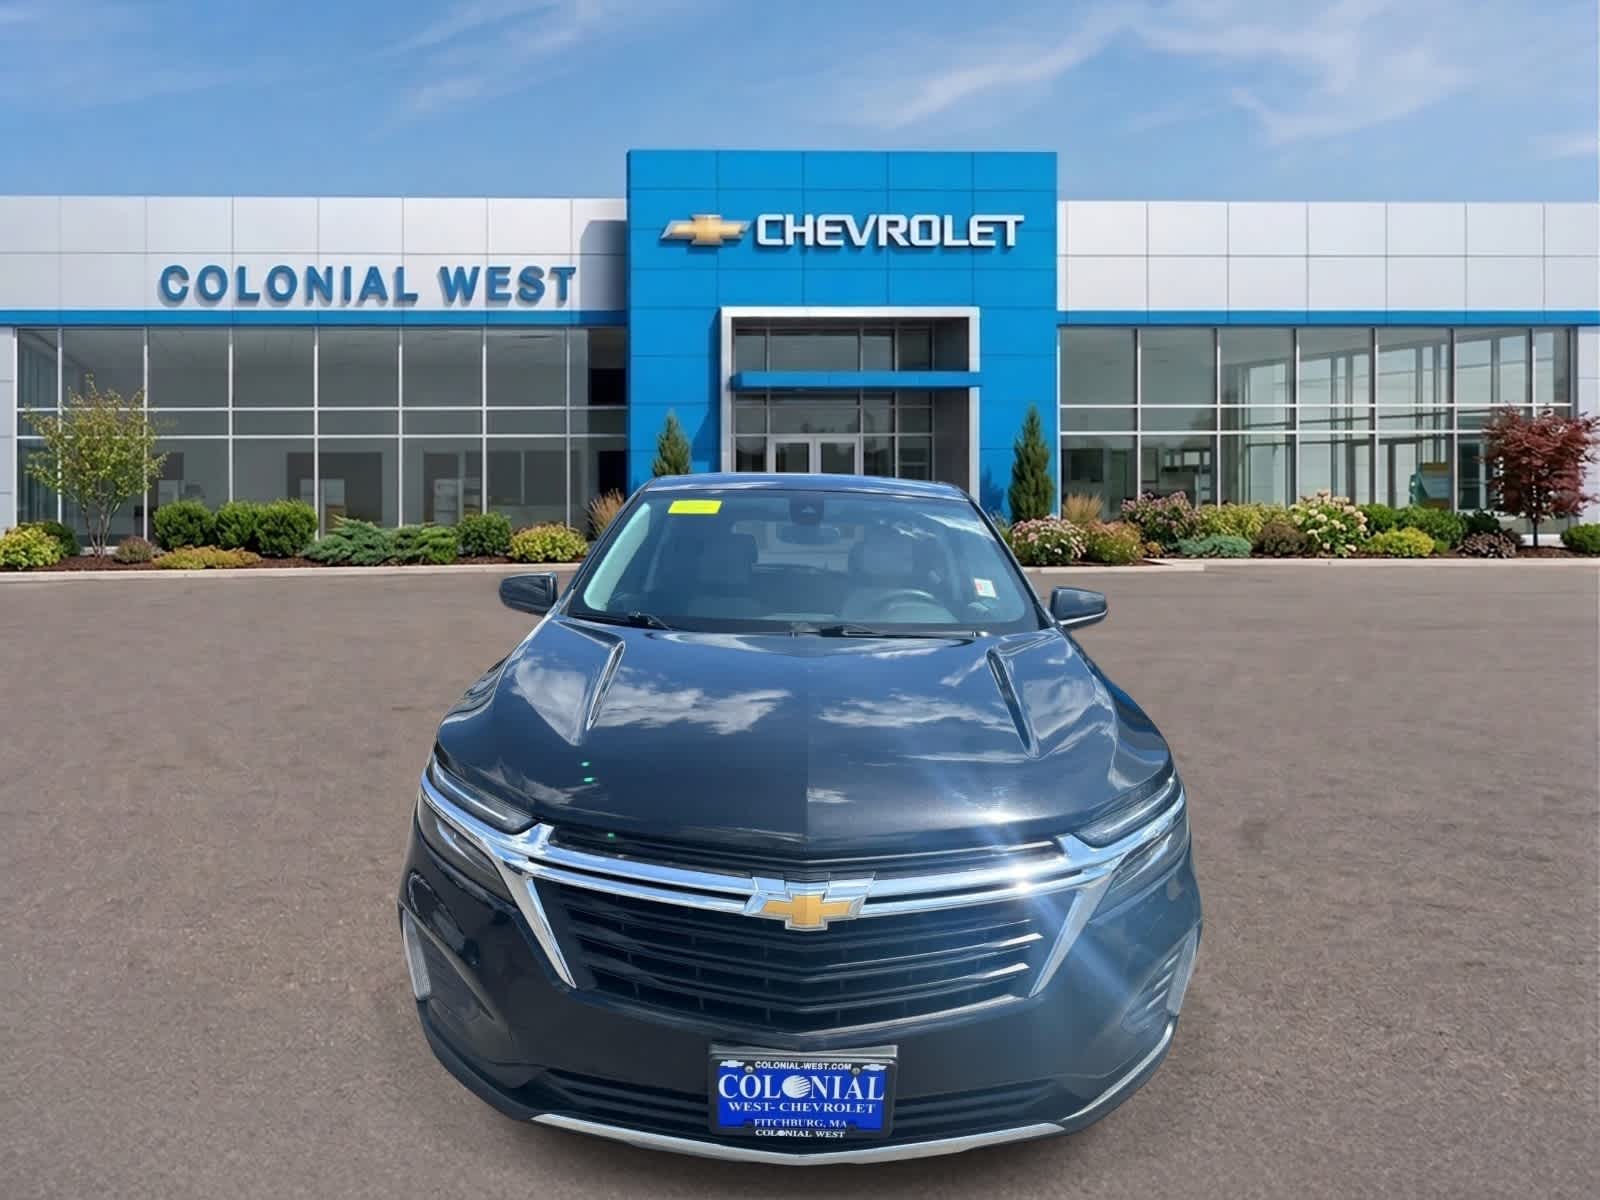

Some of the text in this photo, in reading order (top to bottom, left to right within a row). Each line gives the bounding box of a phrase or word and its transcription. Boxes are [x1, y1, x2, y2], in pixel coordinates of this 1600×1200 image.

[756, 213, 1025, 247] CHEVROLET
[159, 264, 577, 305] COLONIAL WEST
[754, 1060, 852, 1071] COLONIAL-WEST.COM
[718, 1073, 885, 1101] COLONIAL
[779, 1102, 876, 1114] CHEVROLET
[829, 1119, 847, 1128] MA
[755, 1129, 846, 1139] COLONIAL WEST
